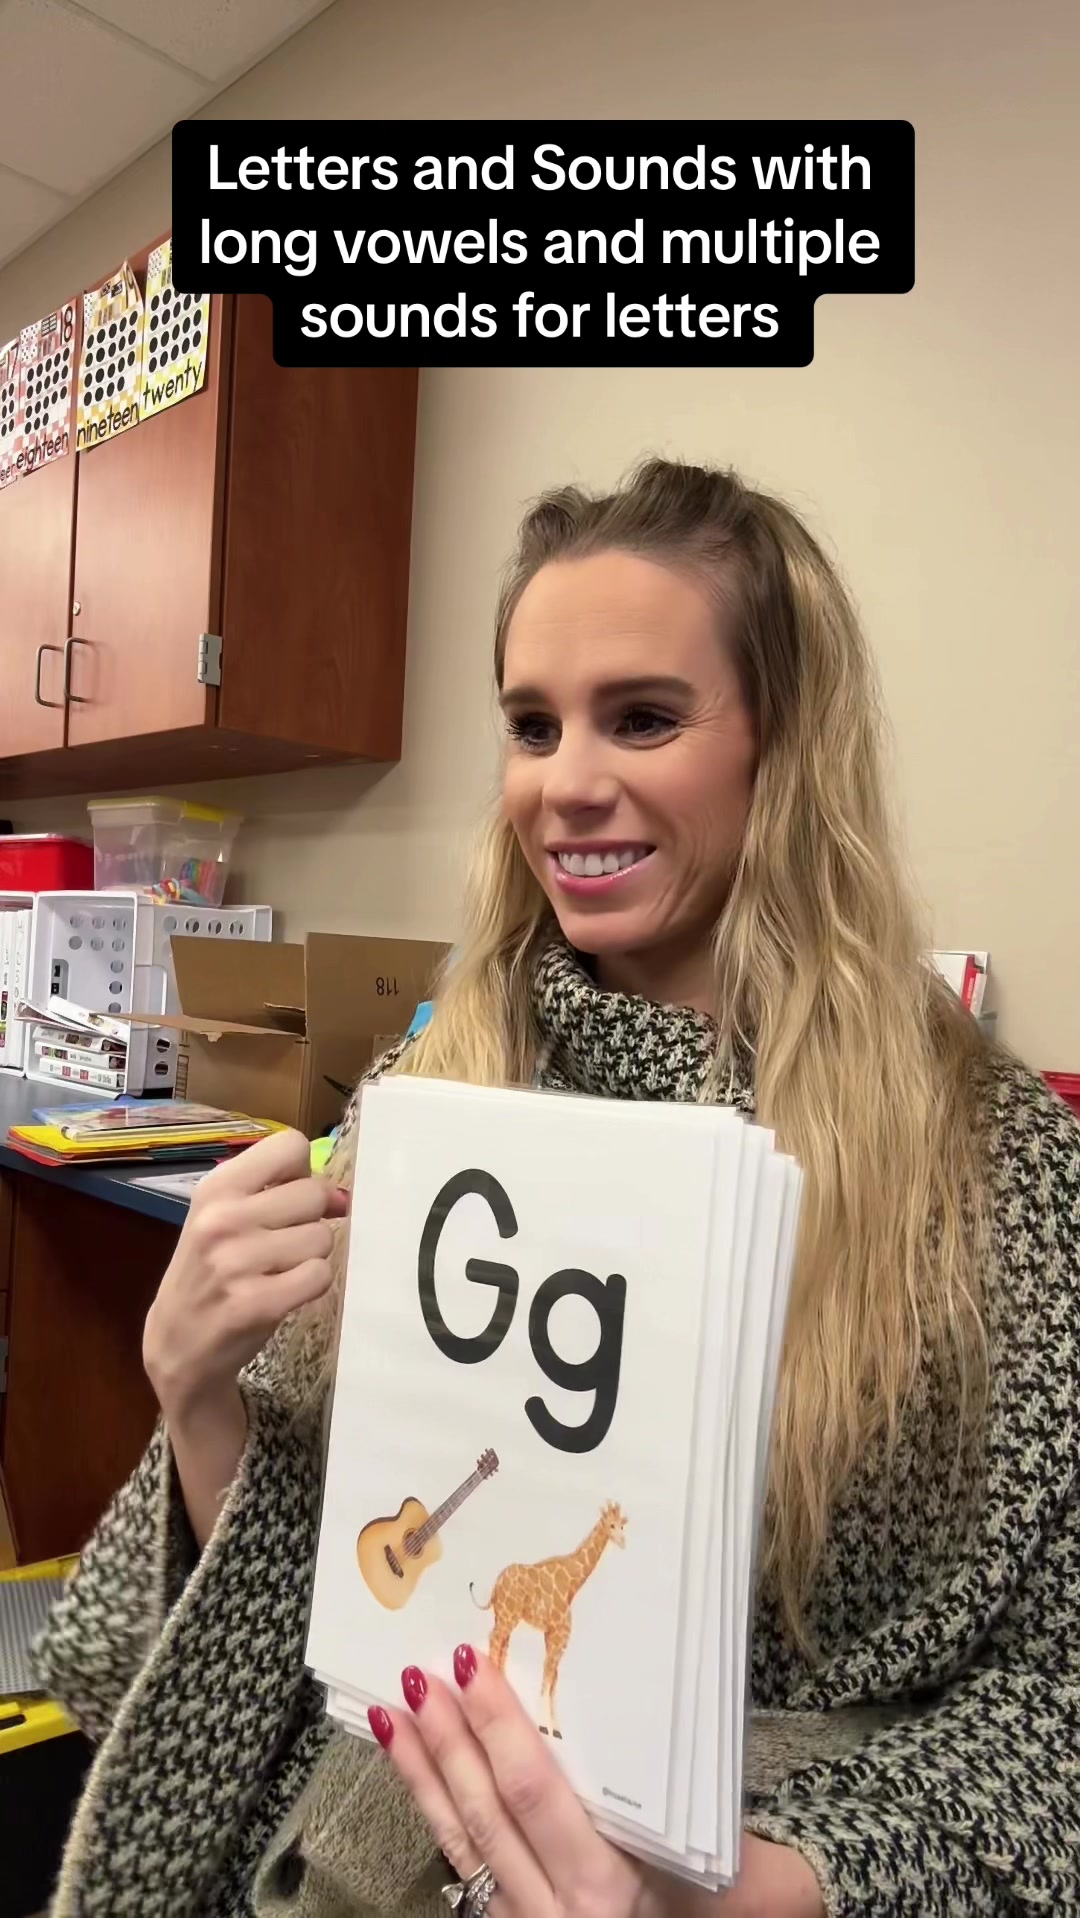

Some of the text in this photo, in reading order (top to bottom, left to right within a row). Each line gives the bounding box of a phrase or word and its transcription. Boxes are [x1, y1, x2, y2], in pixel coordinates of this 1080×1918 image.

[60, 306, 73, 346] 18
[142, 358, 202, 410] twenty
[77, 402, 140, 448] nineteen
[16, 431, 69, 471] eighteen
[376, 976, 400, 996] 118
[418, 1168, 627, 1454] Gg
